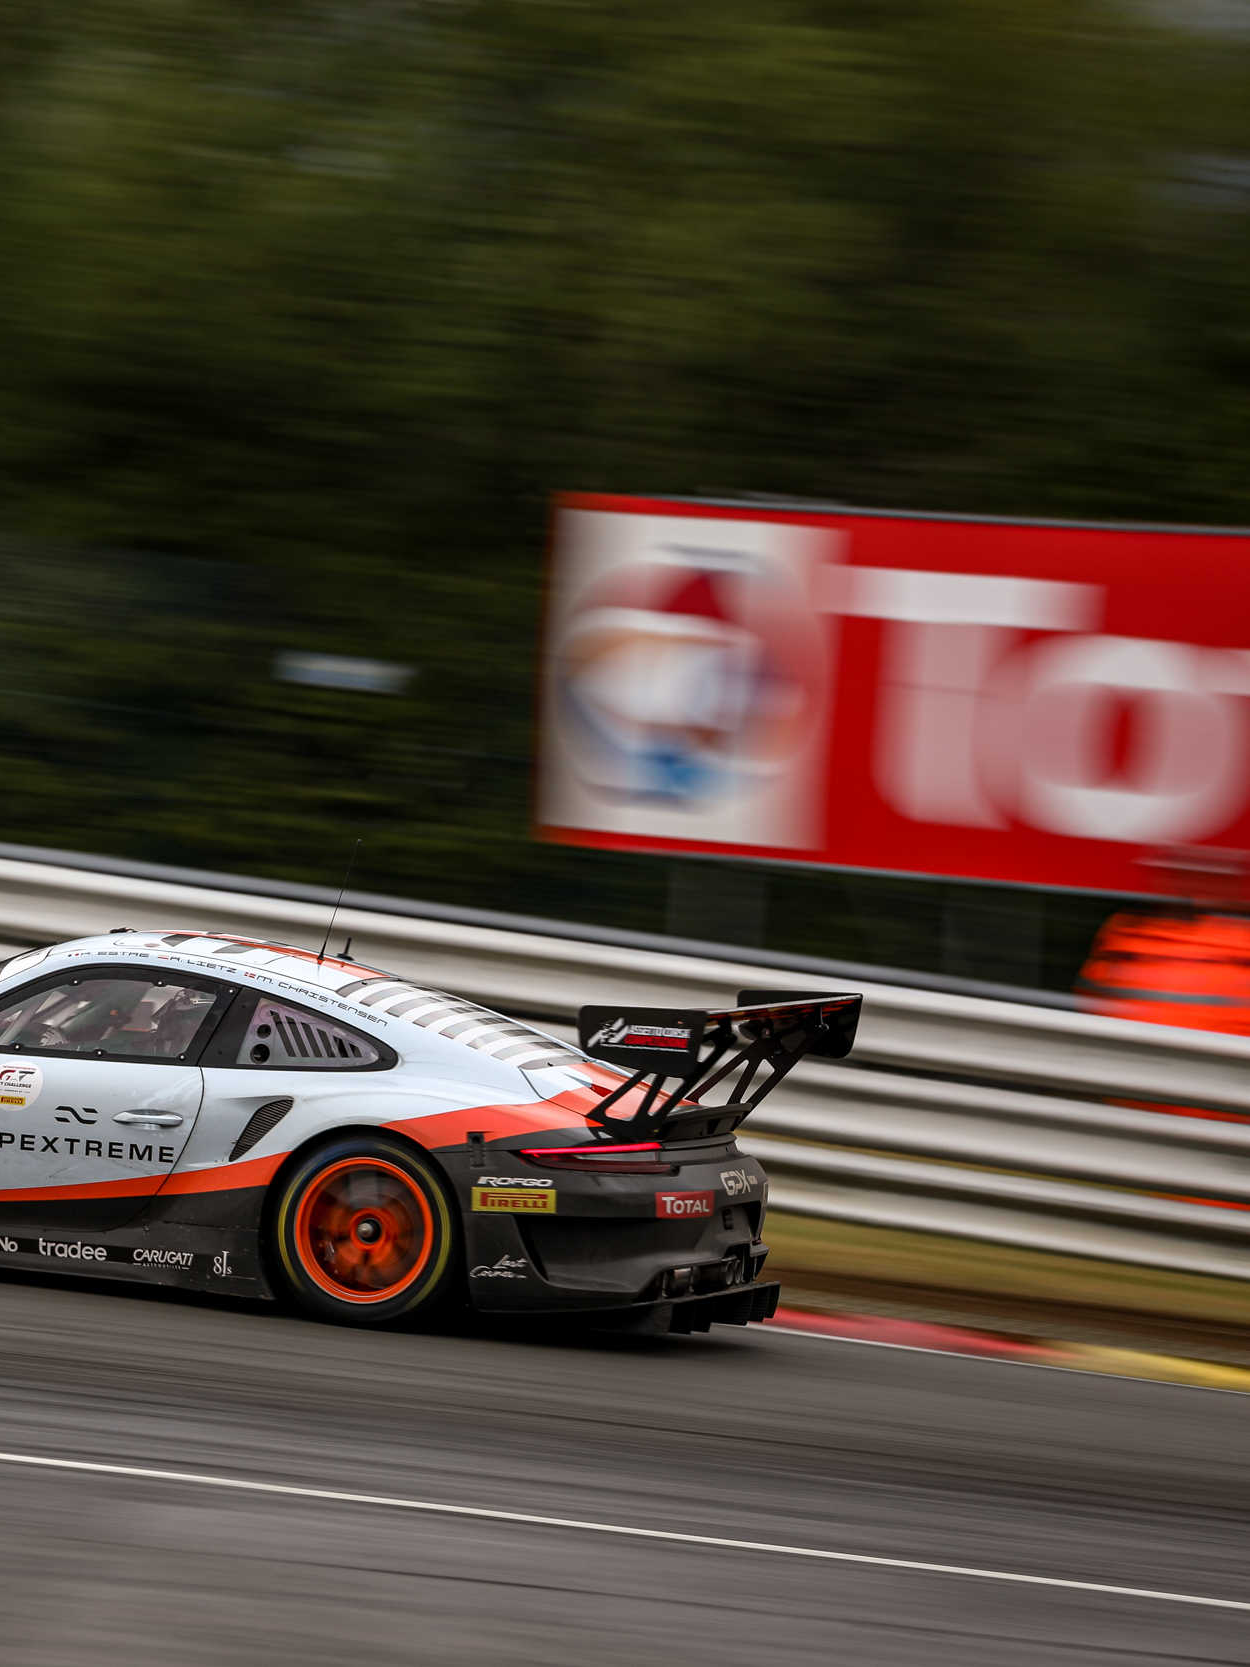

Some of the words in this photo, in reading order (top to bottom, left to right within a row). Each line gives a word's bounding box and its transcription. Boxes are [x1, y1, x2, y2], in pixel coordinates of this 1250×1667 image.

[278, 981, 388, 1027] CHRISTENSEN
[478, 1176, 553, 1187] ROFGO
[480, 1191, 548, 1209] PIRELLI
[661, 1196, 710, 1214] TOTAL
[38, 1237, 108, 1261] tradee
